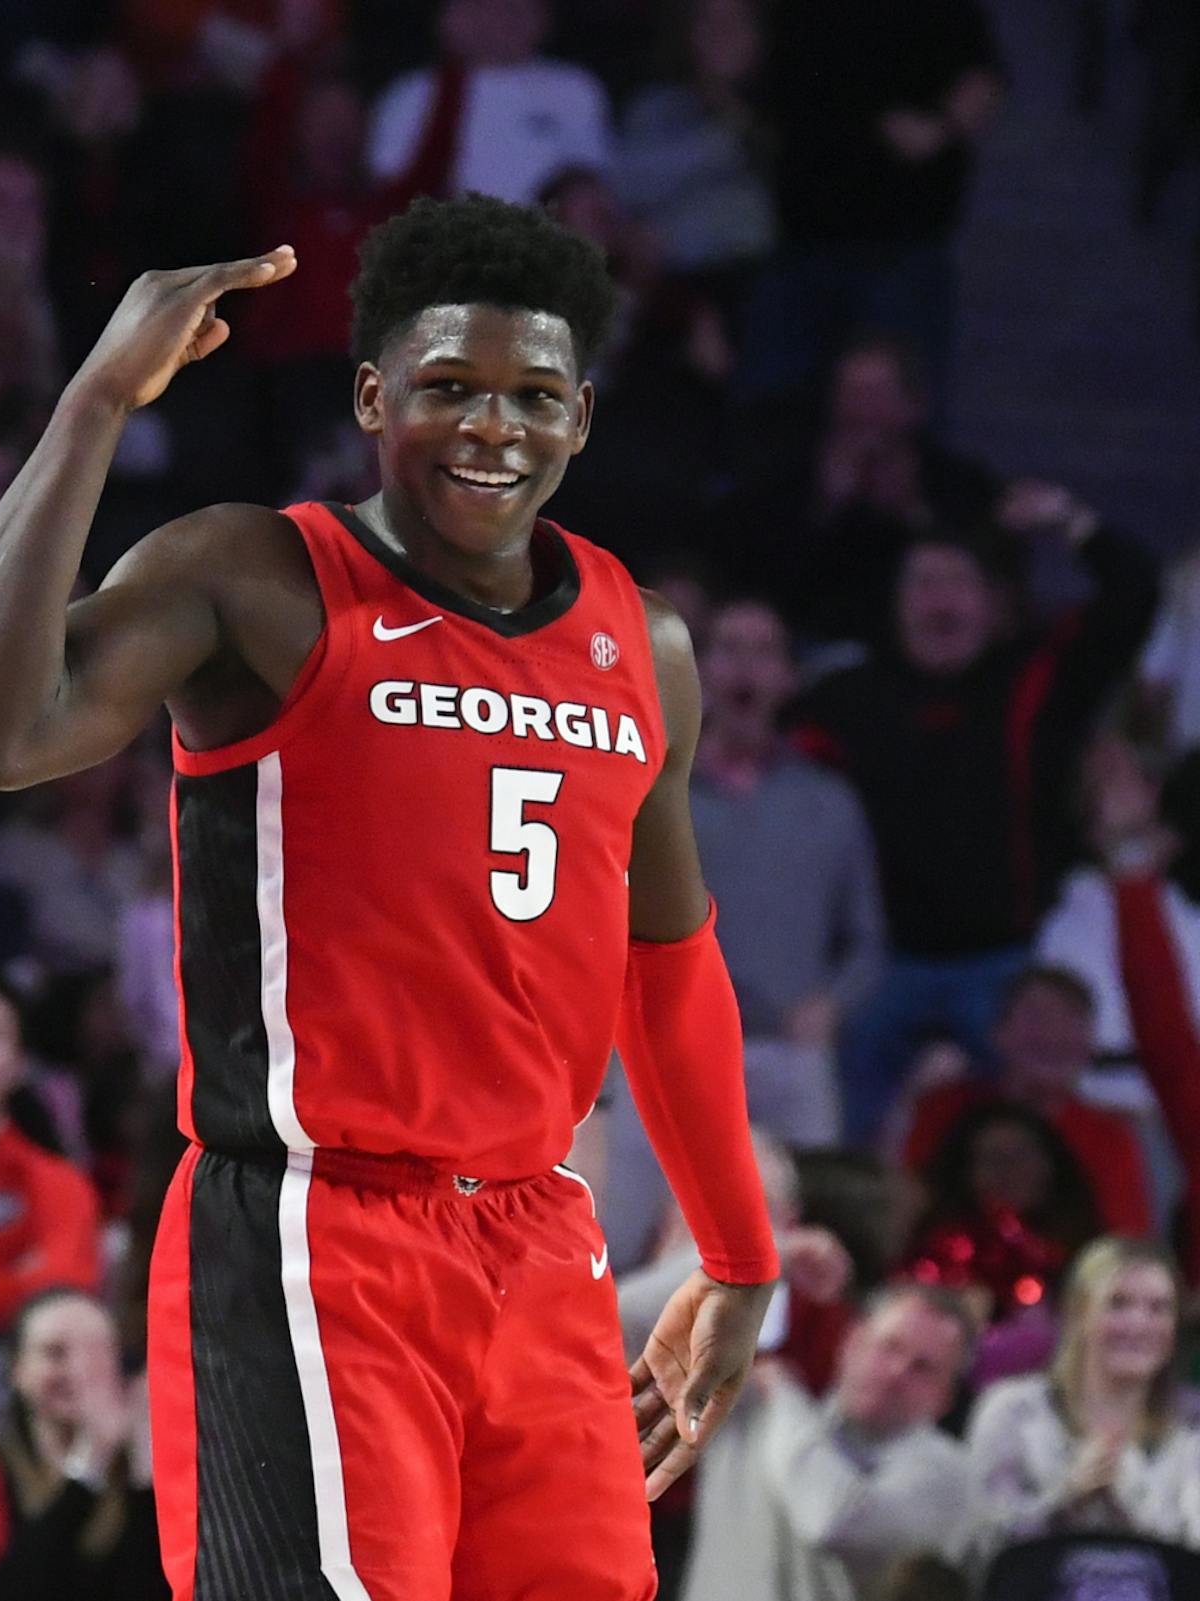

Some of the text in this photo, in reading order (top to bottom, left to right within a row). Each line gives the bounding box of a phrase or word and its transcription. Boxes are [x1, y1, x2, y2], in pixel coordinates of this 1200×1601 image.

[593, 635, 617, 668] SEC
[369, 680, 647, 764] GEORGIA
[489, 765, 565, 922] 5
